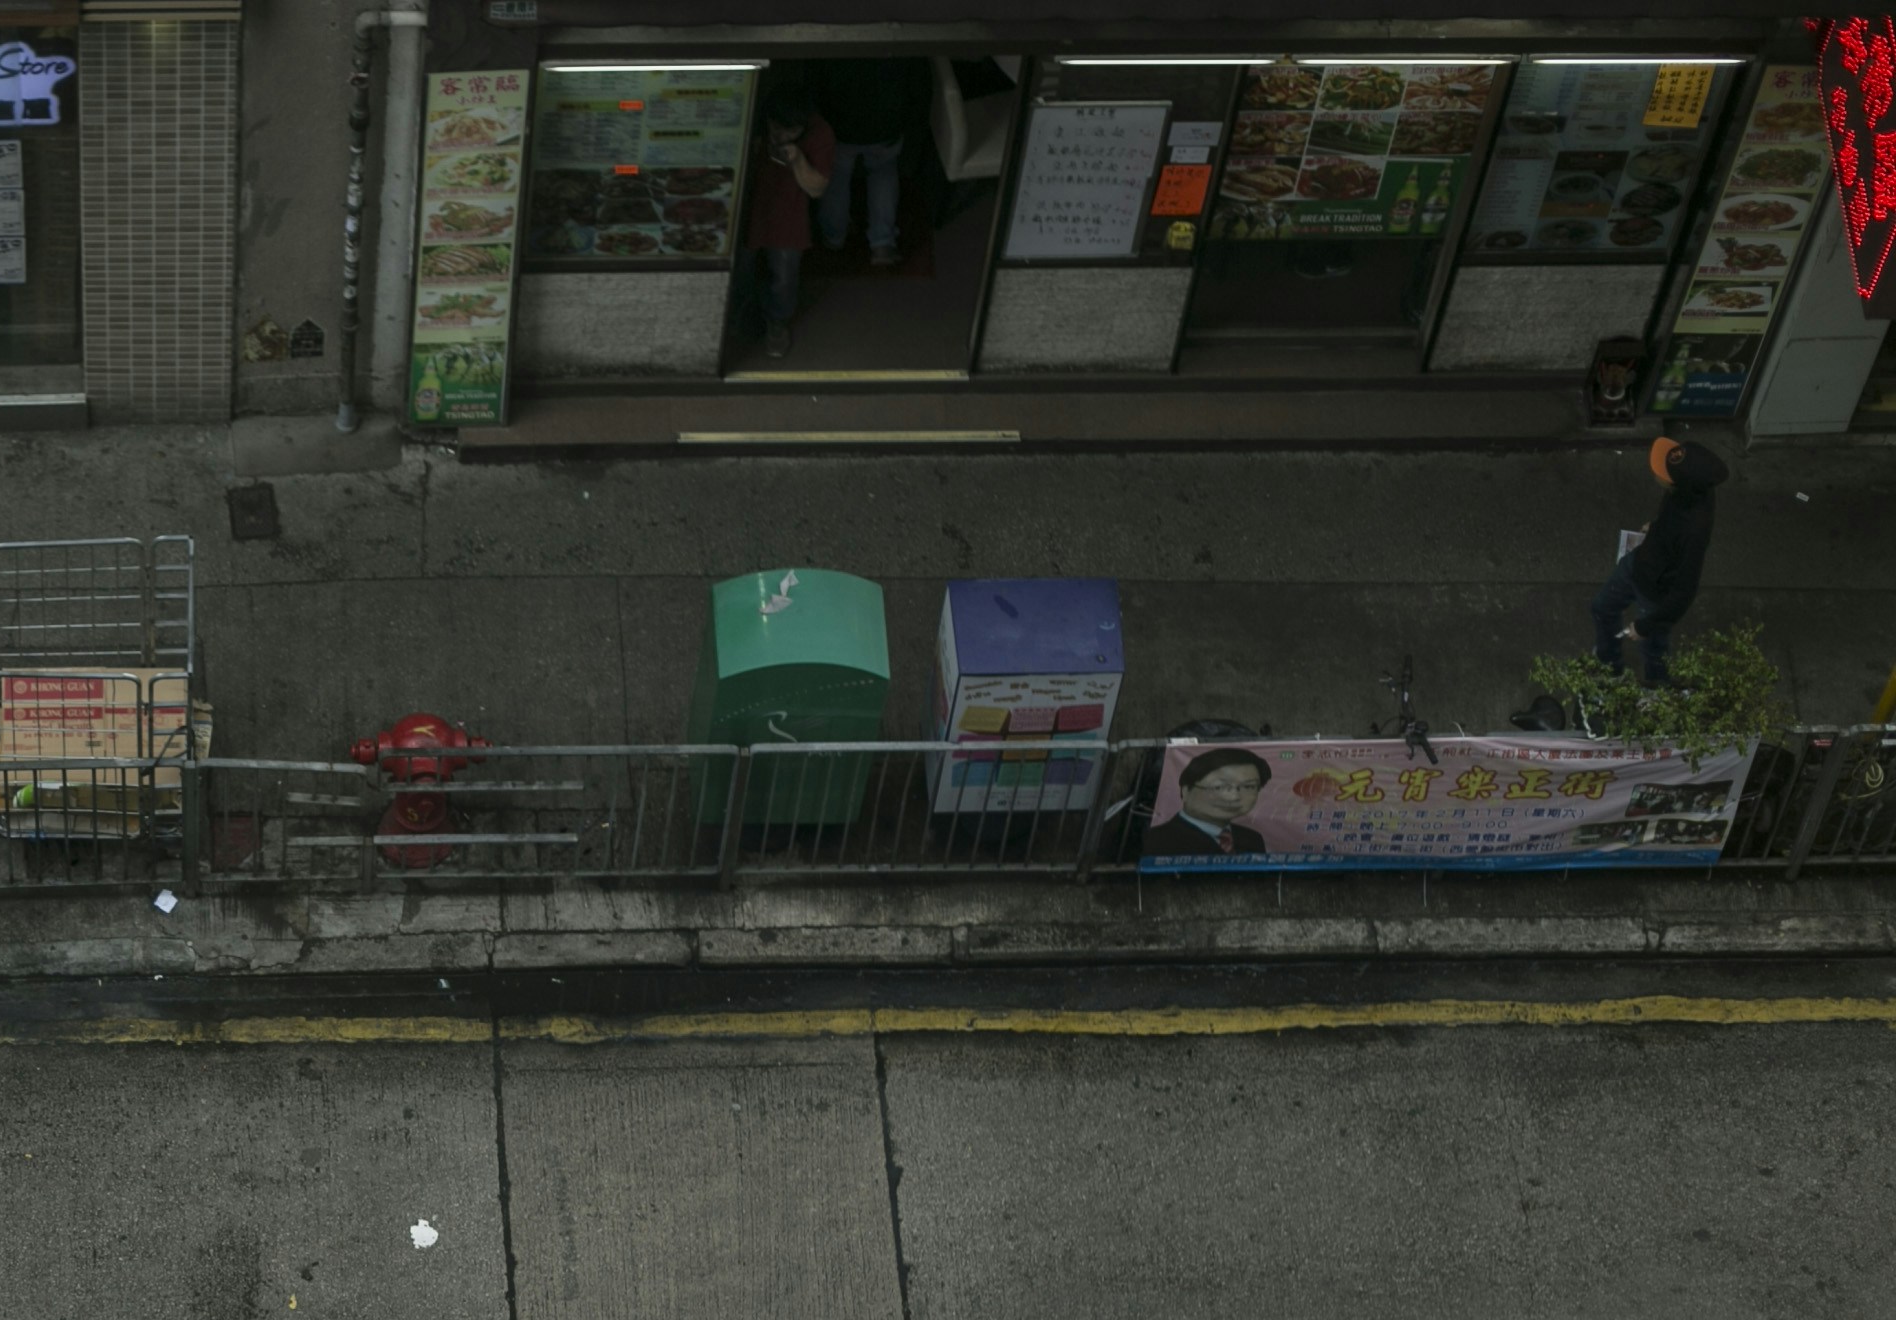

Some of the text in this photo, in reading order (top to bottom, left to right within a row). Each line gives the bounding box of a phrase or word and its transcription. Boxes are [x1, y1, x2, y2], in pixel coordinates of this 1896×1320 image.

[1333, 213, 1383, 223] TRADITION
[30, 680, 64, 693] KHONG
[30, 708, 64, 719] KHONG
[1335, 766, 1619, 802] 元宵樂正街
